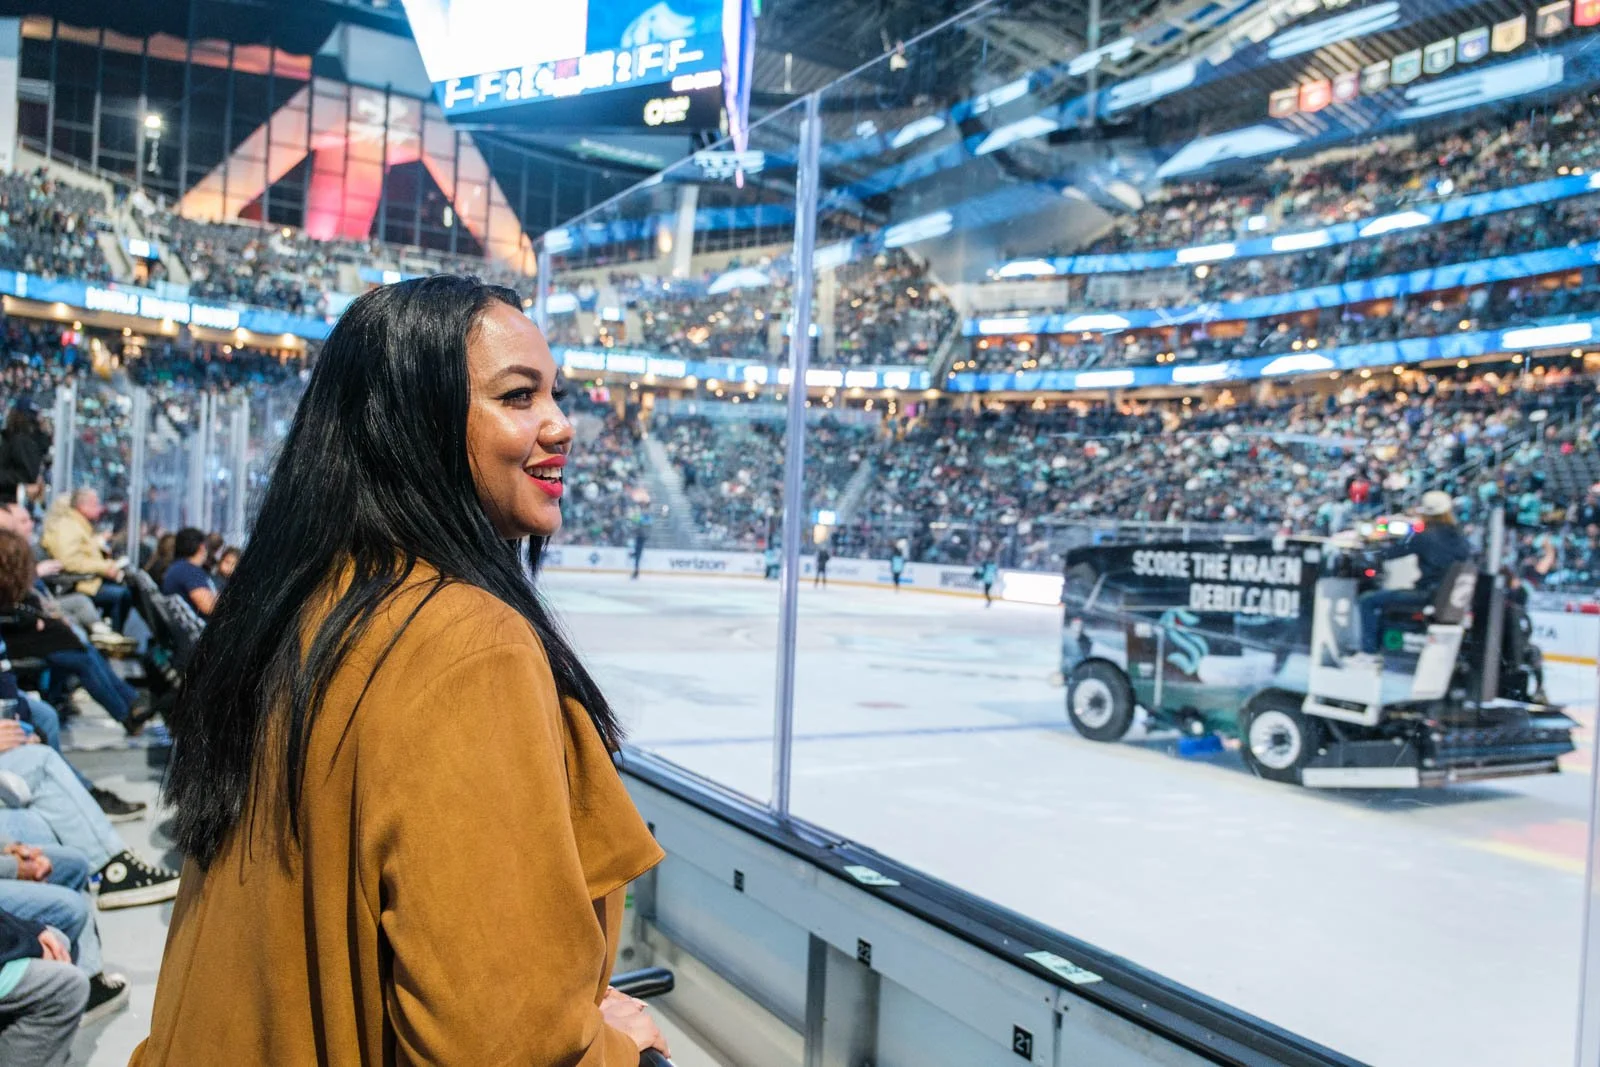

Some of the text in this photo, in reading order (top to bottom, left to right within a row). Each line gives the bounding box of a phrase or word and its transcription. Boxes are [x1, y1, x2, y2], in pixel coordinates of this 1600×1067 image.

[669, 556, 726, 571] verizon
[1132, 550, 1190, 577] SCORE
[1190, 552, 1228, 580] THE
[1189, 582, 1245, 612] DEBIT
[1015, 1032, 1030, 1055] 21
